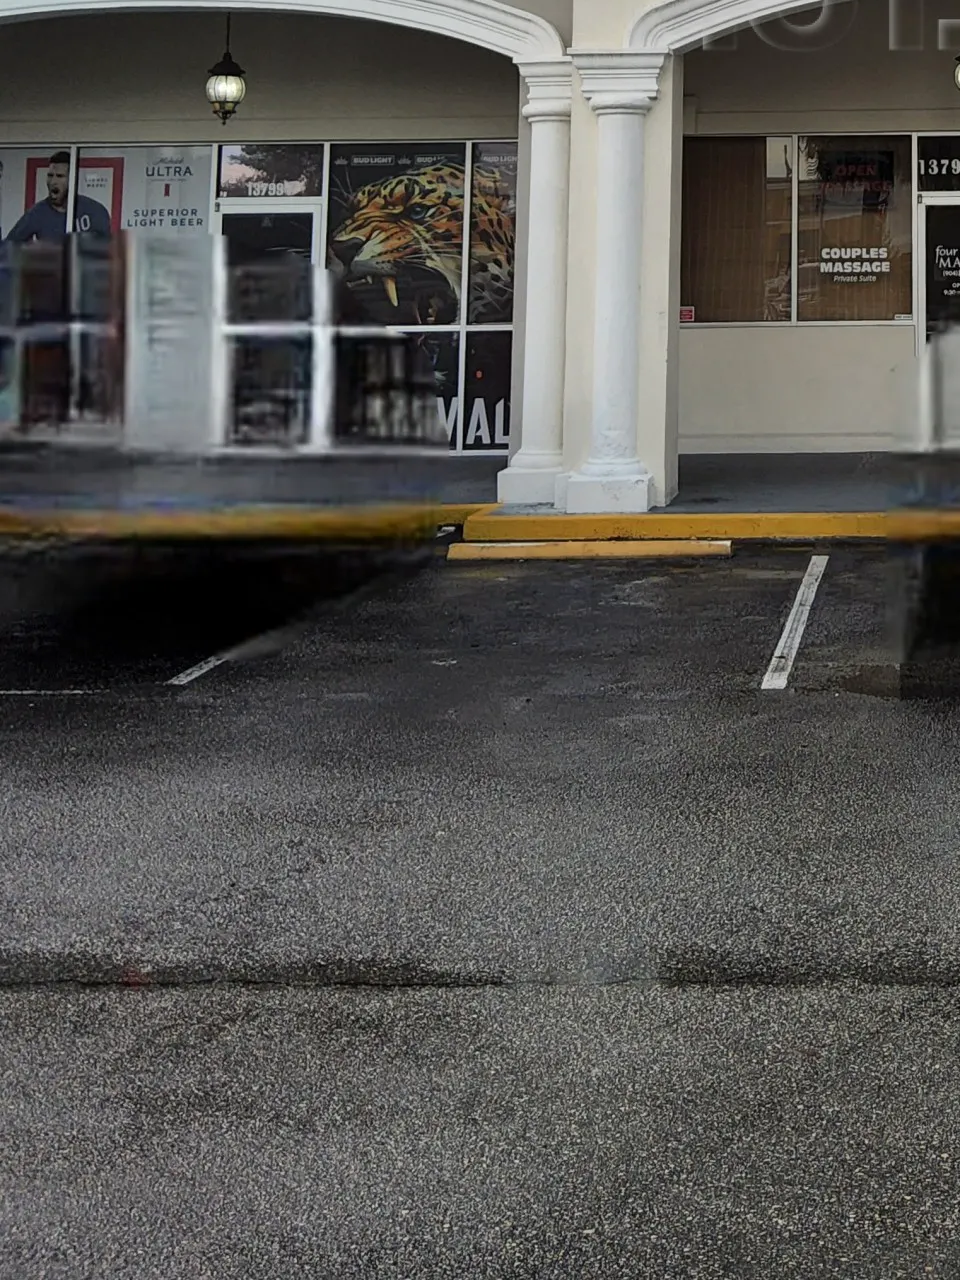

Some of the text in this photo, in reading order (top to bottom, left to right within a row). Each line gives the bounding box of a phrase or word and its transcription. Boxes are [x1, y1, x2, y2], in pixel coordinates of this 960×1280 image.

[146, 166, 193, 177] ULTRA
[834, 163, 877, 176] OPEN
[133, 208, 198, 217] SUPERIOR
[127, 218, 203, 227] LIGHT BEER
[821, 247, 888, 259] COUPLES
[935, 245, 958, 264] four
[820, 261, 891, 273] MASSAGE
